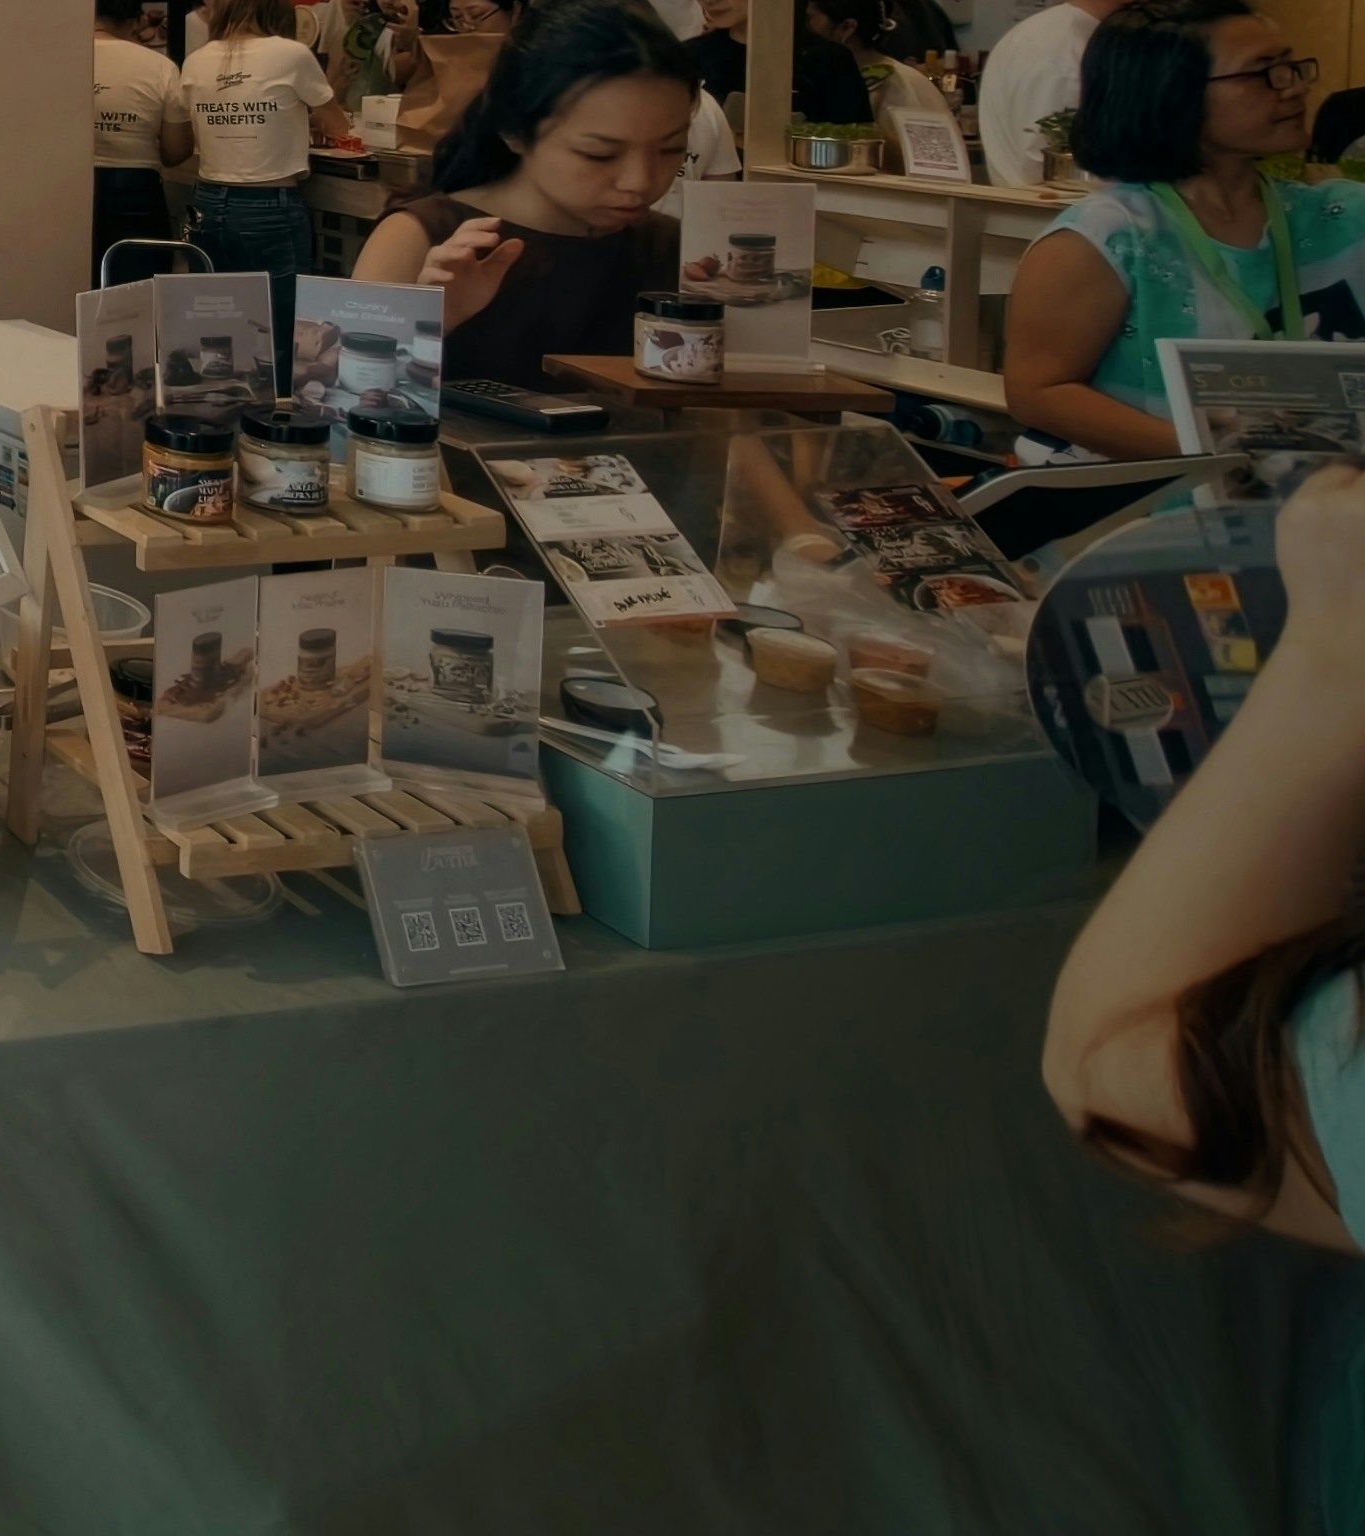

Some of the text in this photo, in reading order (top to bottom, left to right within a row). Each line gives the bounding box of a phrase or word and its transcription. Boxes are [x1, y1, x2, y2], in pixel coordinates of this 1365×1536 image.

[195, 101, 278, 114] TREATS WITH
[100, 111, 138, 123] WITH
[206, 114, 266, 126] BENEFITS
